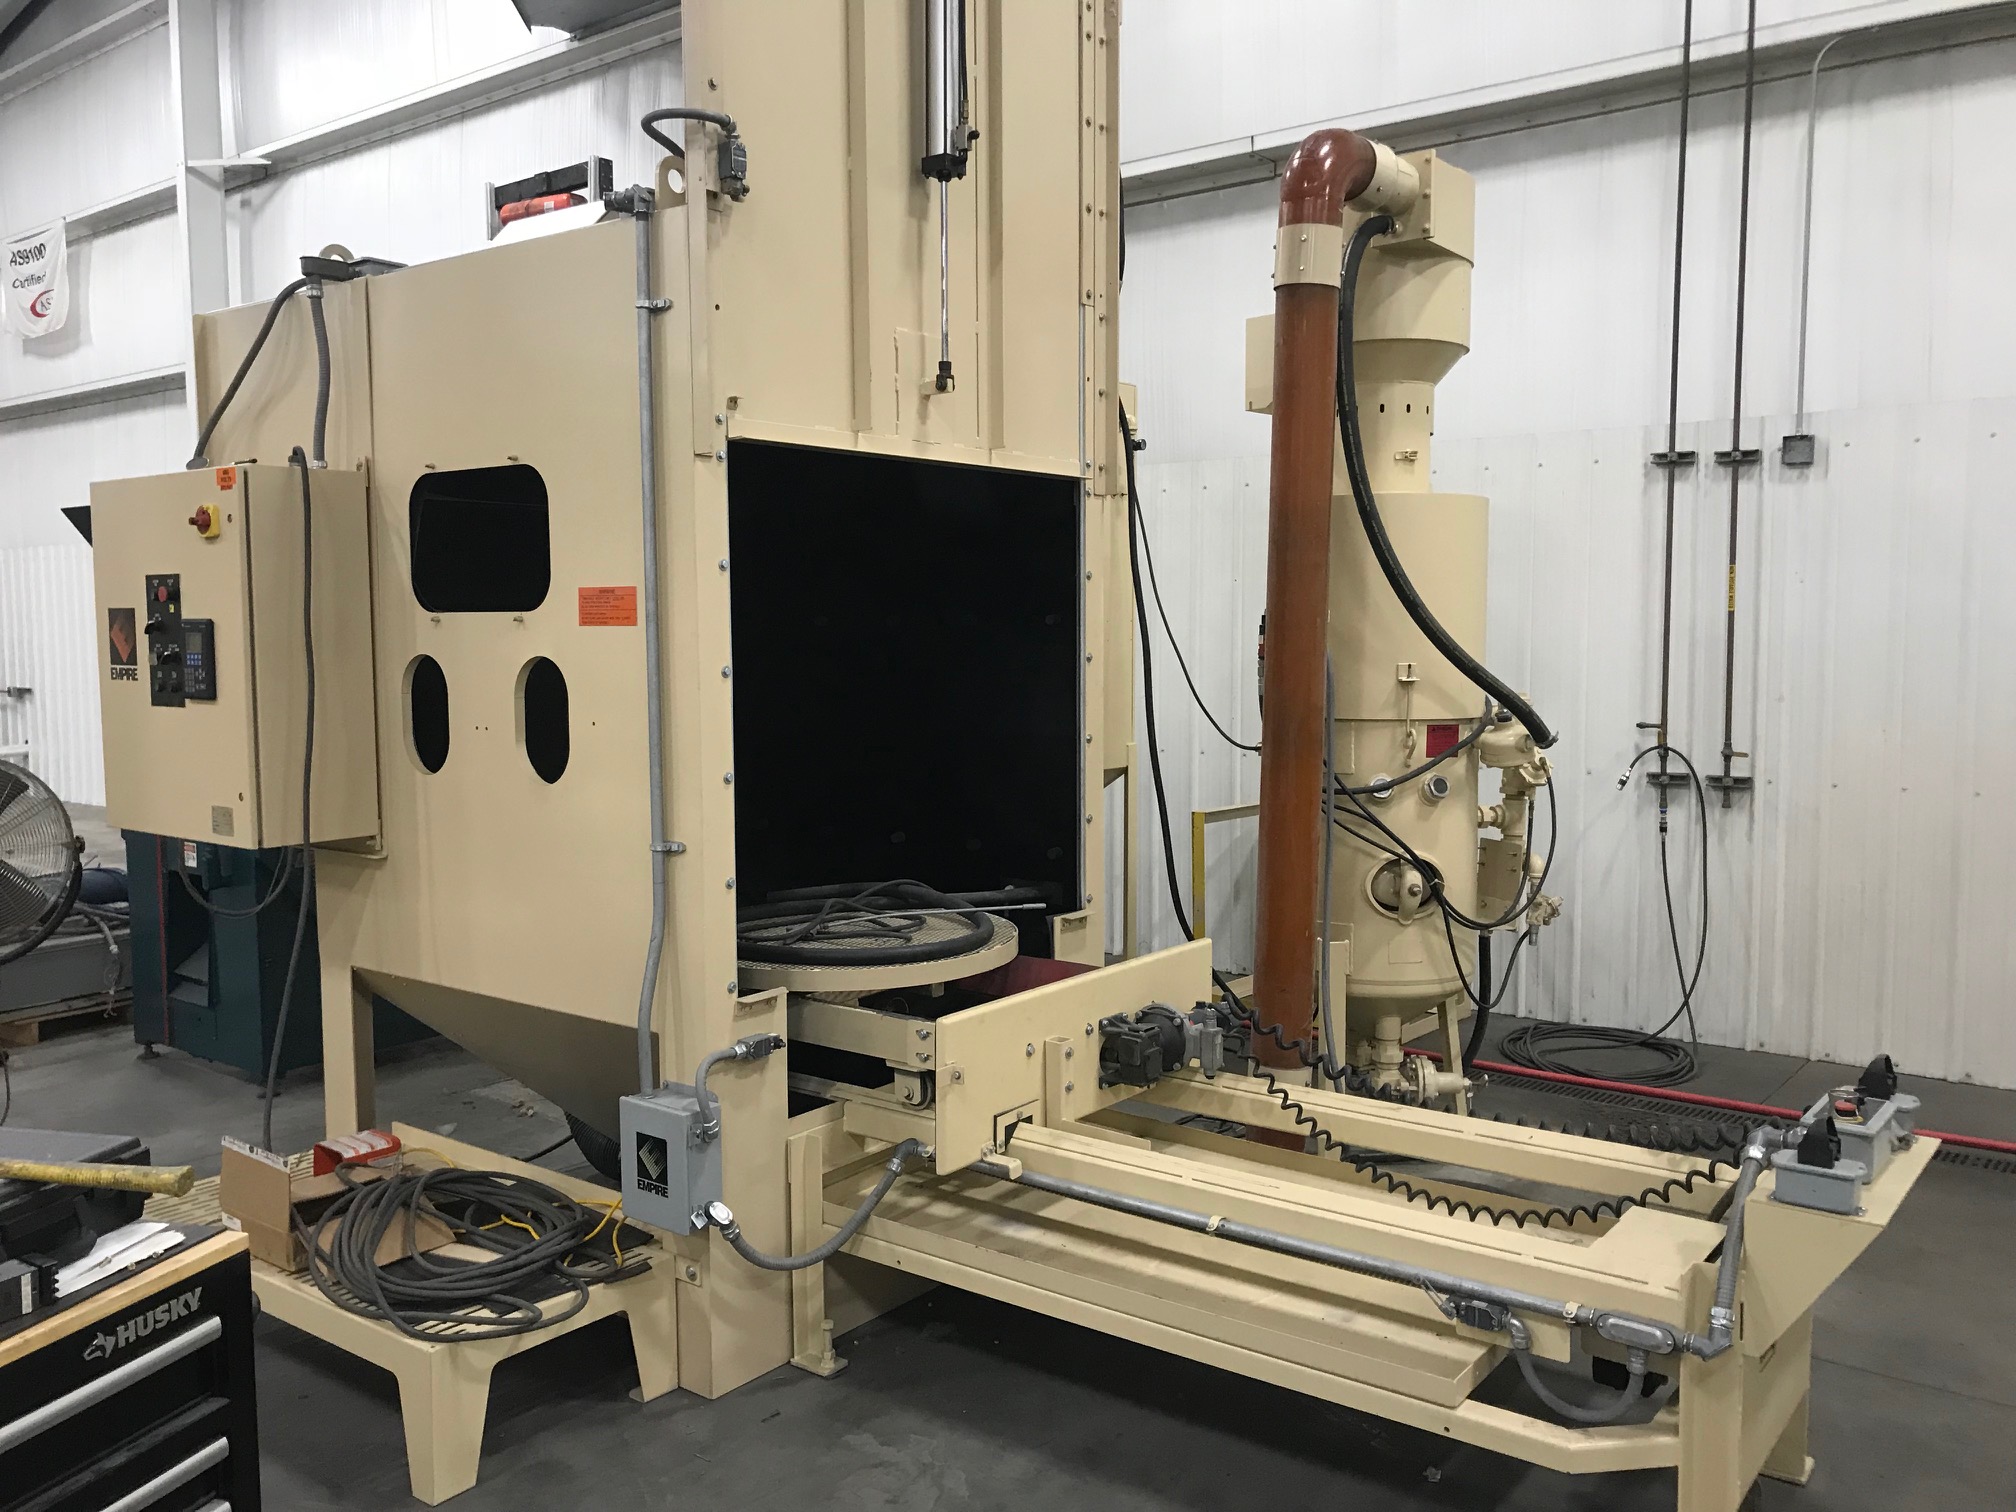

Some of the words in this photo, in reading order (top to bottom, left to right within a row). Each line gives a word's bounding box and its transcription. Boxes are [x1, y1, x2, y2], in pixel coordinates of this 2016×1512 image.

[10, 243, 46, 266] AS9100
[111, 667, 139, 682] EMPIRE
[638, 1179, 669, 1198] EMPIRE
[118, 1287, 202, 1348] HUSKY
